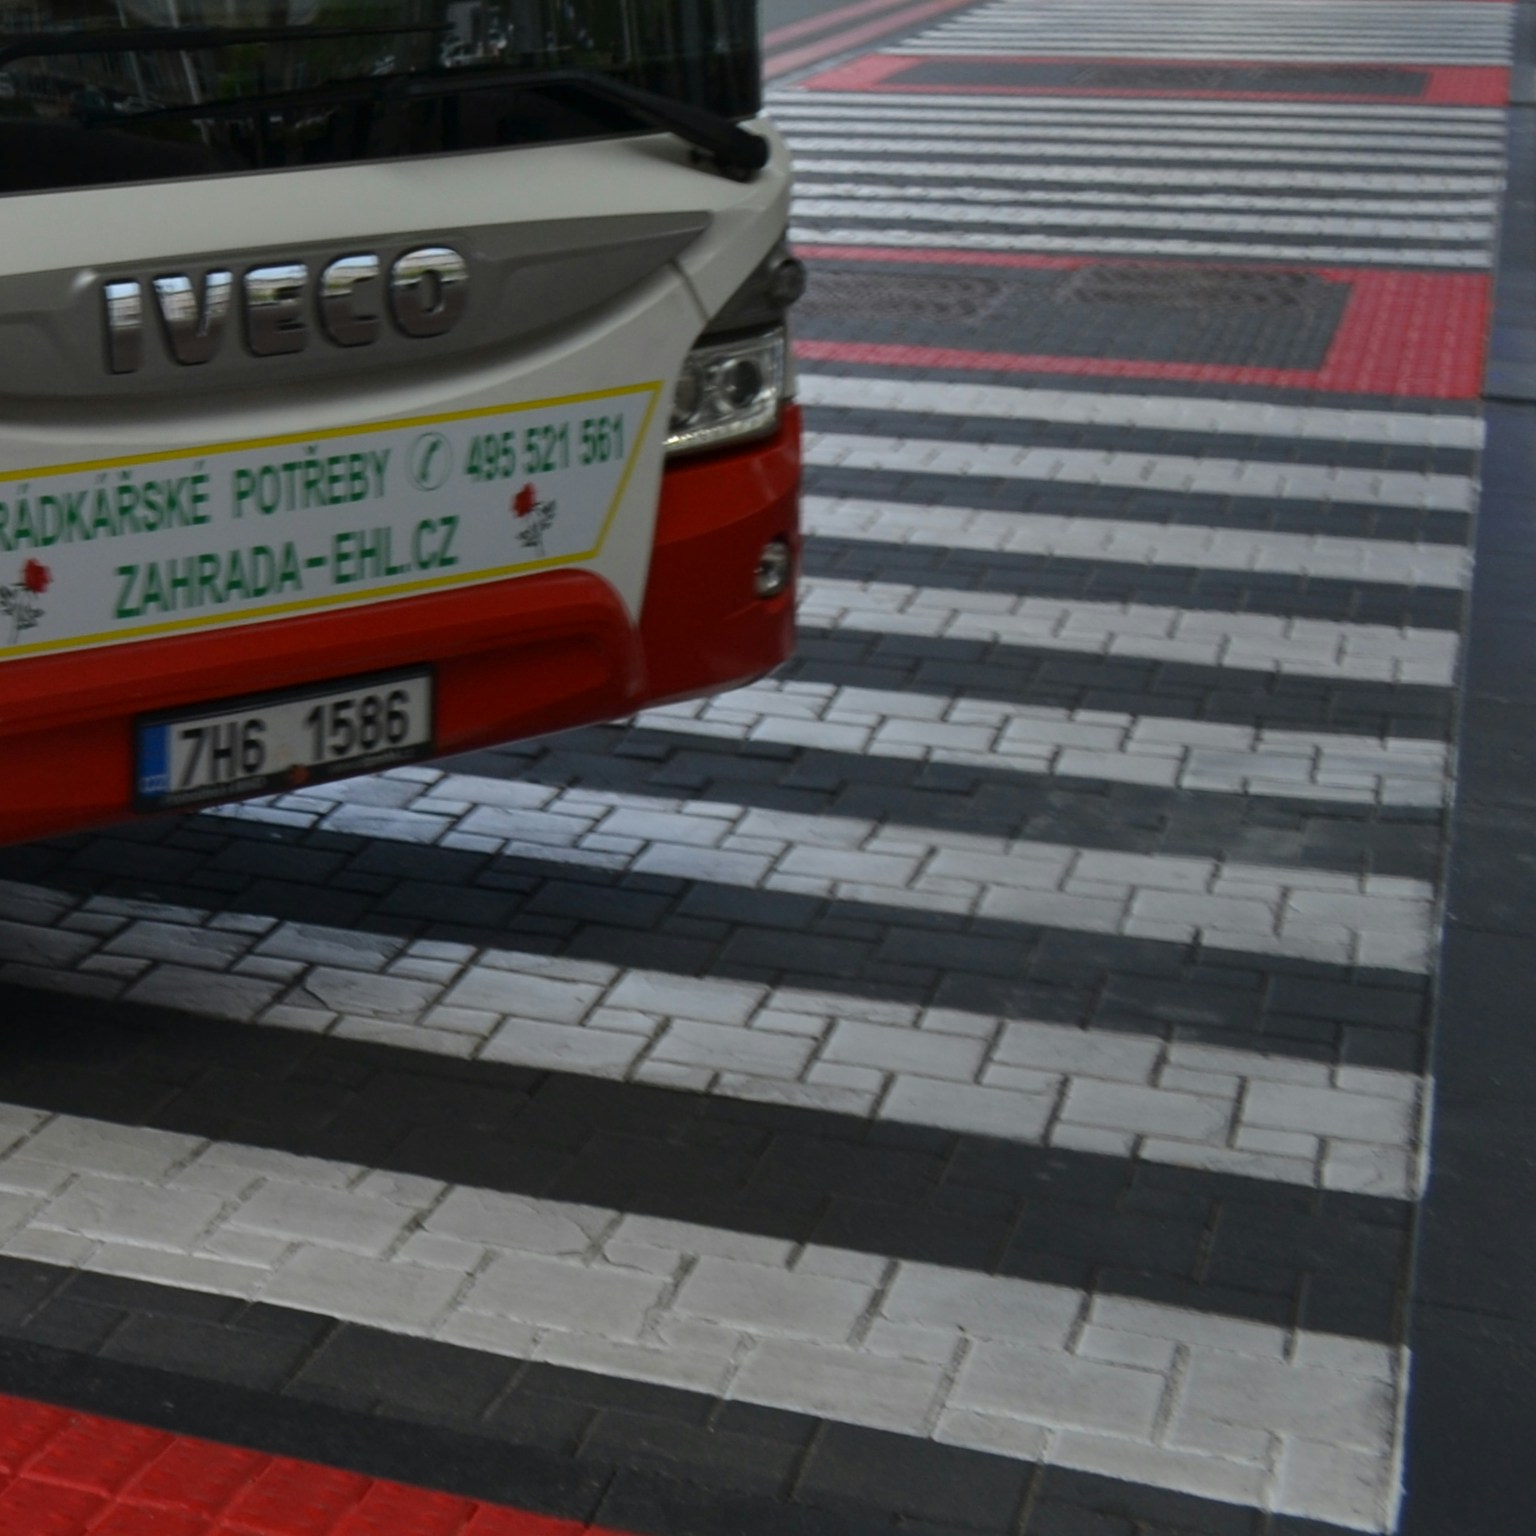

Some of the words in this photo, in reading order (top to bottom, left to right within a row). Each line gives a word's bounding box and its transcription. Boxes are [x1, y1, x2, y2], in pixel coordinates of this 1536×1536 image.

[103, 246, 469, 375] IVECO
[232, 445, 391, 519] POTŘEBY
[464, 430, 516, 483] 495
[526, 422, 571, 475] 521
[581, 413, 625, 466] 561
[178, 717, 267, 788] 7H6
[303, 688, 410, 761] 1586
